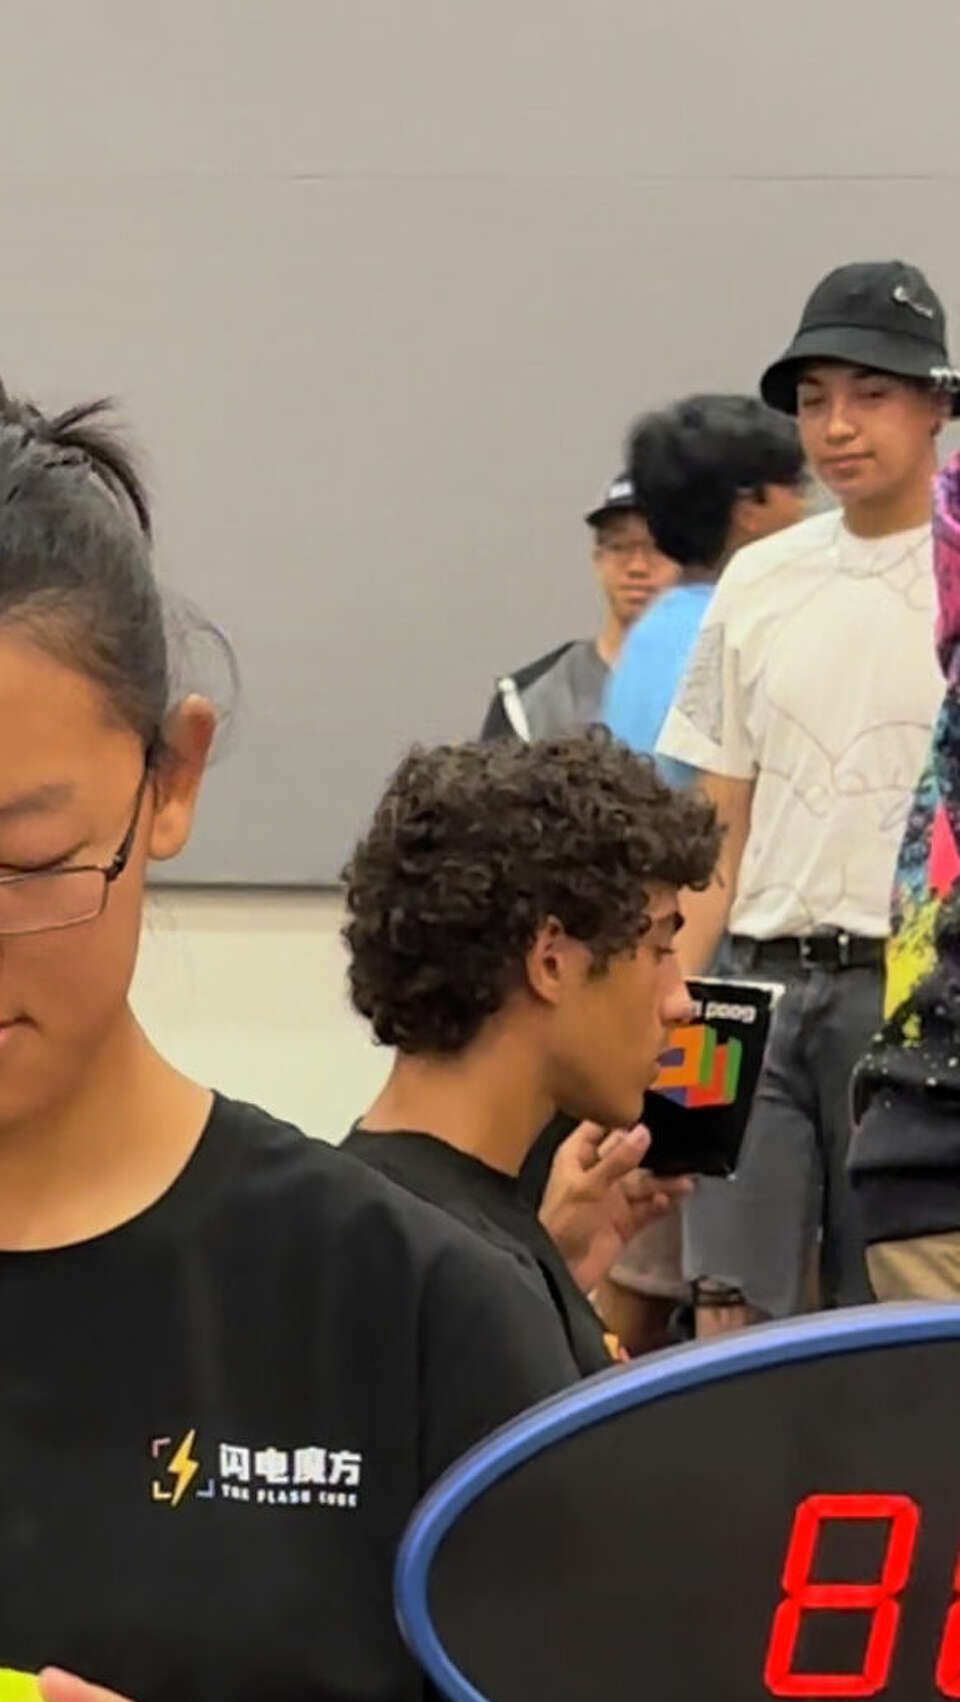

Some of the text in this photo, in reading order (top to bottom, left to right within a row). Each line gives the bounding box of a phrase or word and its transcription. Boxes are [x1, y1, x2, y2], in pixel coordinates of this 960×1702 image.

[221, 1483, 358, 1508] THE FLASH CUBE
